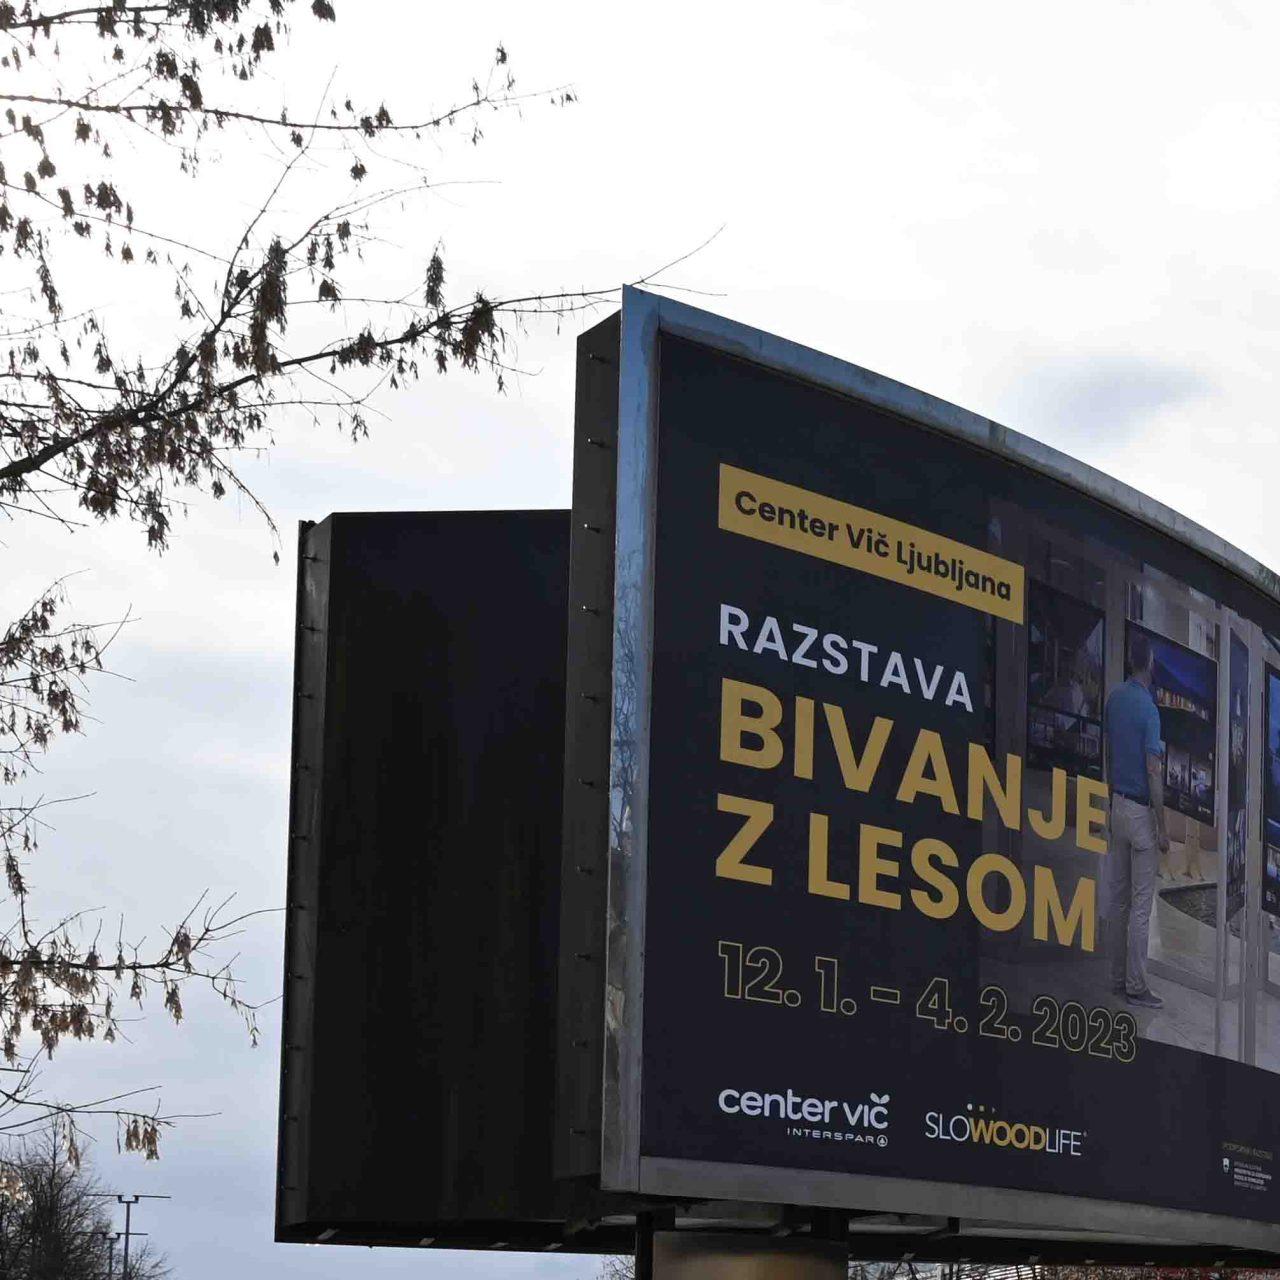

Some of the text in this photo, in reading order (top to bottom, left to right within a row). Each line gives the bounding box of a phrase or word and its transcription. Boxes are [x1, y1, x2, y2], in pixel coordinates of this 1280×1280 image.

[734, 490, 1012, 602] Center Vič Ljubljana
[719, 603, 974, 714] RAZSTAVA
[719, 677, 1110, 855] BIVANJE
[715, 793, 1097, 953] Z LESOM
[718, 940, 801, 1008] 12.
[815, 956, 858, 1016] 1.
[916, 977, 969, 1034] 4.
[979, 986, 1022, 1042] 2.
[1032, 995, 1138, 1063] 2023
[718, 1088, 890, 1130] center vič
[786, 1127, 875, 1144] INTERSPAR
